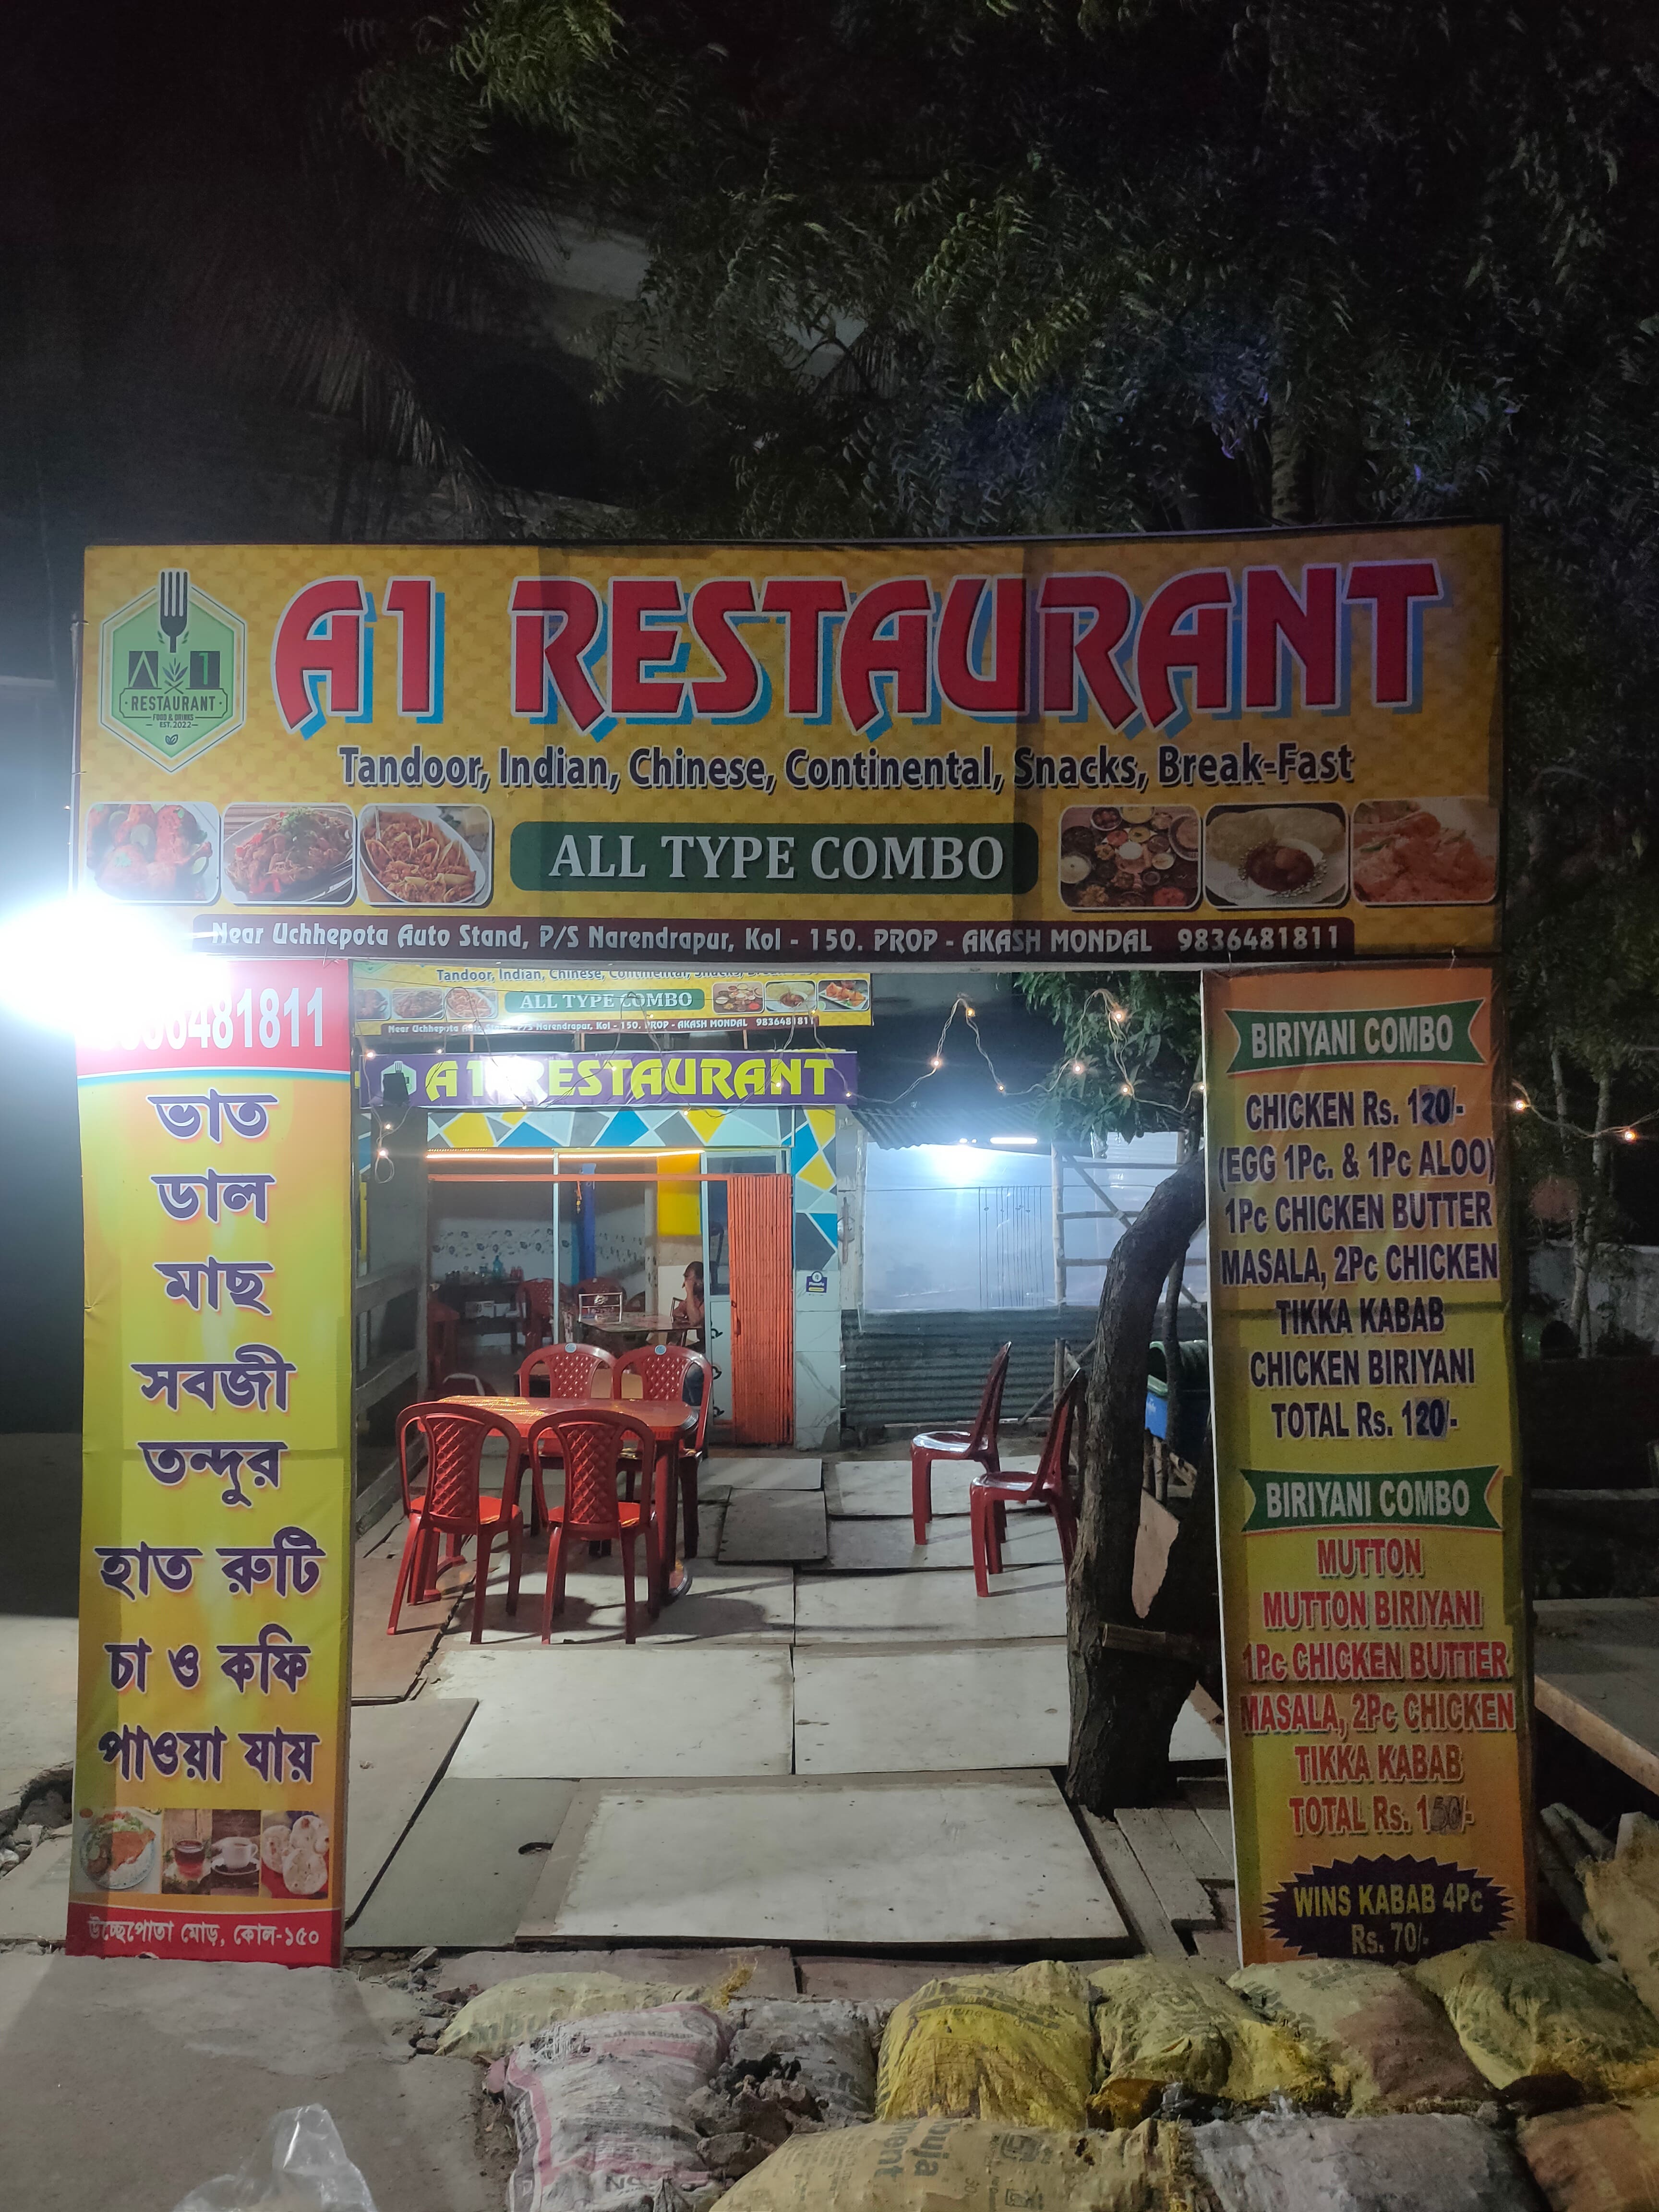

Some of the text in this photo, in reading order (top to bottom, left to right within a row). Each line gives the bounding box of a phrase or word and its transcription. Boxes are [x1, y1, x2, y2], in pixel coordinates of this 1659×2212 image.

[270, 559, 1446, 741] A1 RESTAURANT
[131, 696, 216, 711] RESTAURANT
[337, 741, 1354, 795] Tandoor, Indian, Chinese, Continental, Snacks, Break-Fast
[549, 833, 1003, 881] ALL TYPE COMBO
[212, 922, 265, 946] Near
[272, 923, 389, 950] Uchhepota
[397, 923, 450, 949] Auto
[459, 924, 529, 950] Stand,
[539, 924, 578, 948] P/S
[589, 926, 733, 955] Narendrapur,
[745, 926, 781, 951] Kol
[810, 927, 863, 952] 150.
[874, 927, 937, 955] PROP
[962, 927, 1040, 954] AKASH
[1051, 927, 1153, 954] MONDAL
[1177, 925, 1339, 952] 9836481811
[436, 968, 495, 982] Tandoor,
[499, 969, 545, 982] Indian,
[549, 969, 606, 982] Chinese,
[520, 992, 692, 1010] ALL TYPE COMBO
[388, 1024, 409, 1033] Near
[536, 1022, 593, 1032] Narendrapur,
[596, 1021, 610, 1030] Kol
[677, 1019, 708, 1029] AKASH
[710, 1018, 748, 1028] MONDAL
[1251, 1014, 1453, 1059] BIRIYANI COMBO
[425, 1060, 484, 1102] A1
[145, 1087, 280, 1144] ভাত
[1245, 1091, 1355, 1131] CHICKEN
[1362, 1090, 1399, 1127] Rs.
[1218, 1136, 1497, 1193] (EGG 1Pc. & 1Pc ALOO)
[149, 1167, 277, 1224] ডাল
[1225, 1189, 1493, 1234] 1Pc CHICKEN BUTTER
[152, 1255, 275, 1316] মাছ
[1221, 1242, 1499, 1292] MASALA, 2Pc CHICKEN
[1275, 1296, 1446, 1335] TIKKA KABAB
[130, 1343, 298, 1412] সবজী
[1250, 1347, 1476, 1388] CHICKEN BIRIYANI
[1271, 1401, 1350, 1439] TOTAL
[1357, 1400, 1393, 1437] Rs.
[136, 1441, 289, 1508] তন্দুর
[1265, 1479, 1470, 1519] BIRIYANI COMBO
[94, 1526, 327, 1602] হাত রুটি
[1317, 1537, 1424, 1577] MUTTON
[1262, 1589, 1483, 1630] MUTTON BIRIYANI
[103, 1623, 312, 1695] চা ও কফি
[1242, 1640, 1511, 1682] 1Pc CHICKEN BUTTER
[1240, 1689, 1517, 1743] MASALA, 2Pc CHICKEN
[98, 1724, 322, 1783] পাওয়া যায়
[1295, 1743, 1465, 1784] TIKKA KABAB
[1289, 1795, 1368, 1836] TOTAL
[1372, 1793, 1411, 1835] Rs.
[1293, 1882, 1484, 1918] WINS KABAB 4Pc
[1351, 1924, 1385, 1955] Rs.
